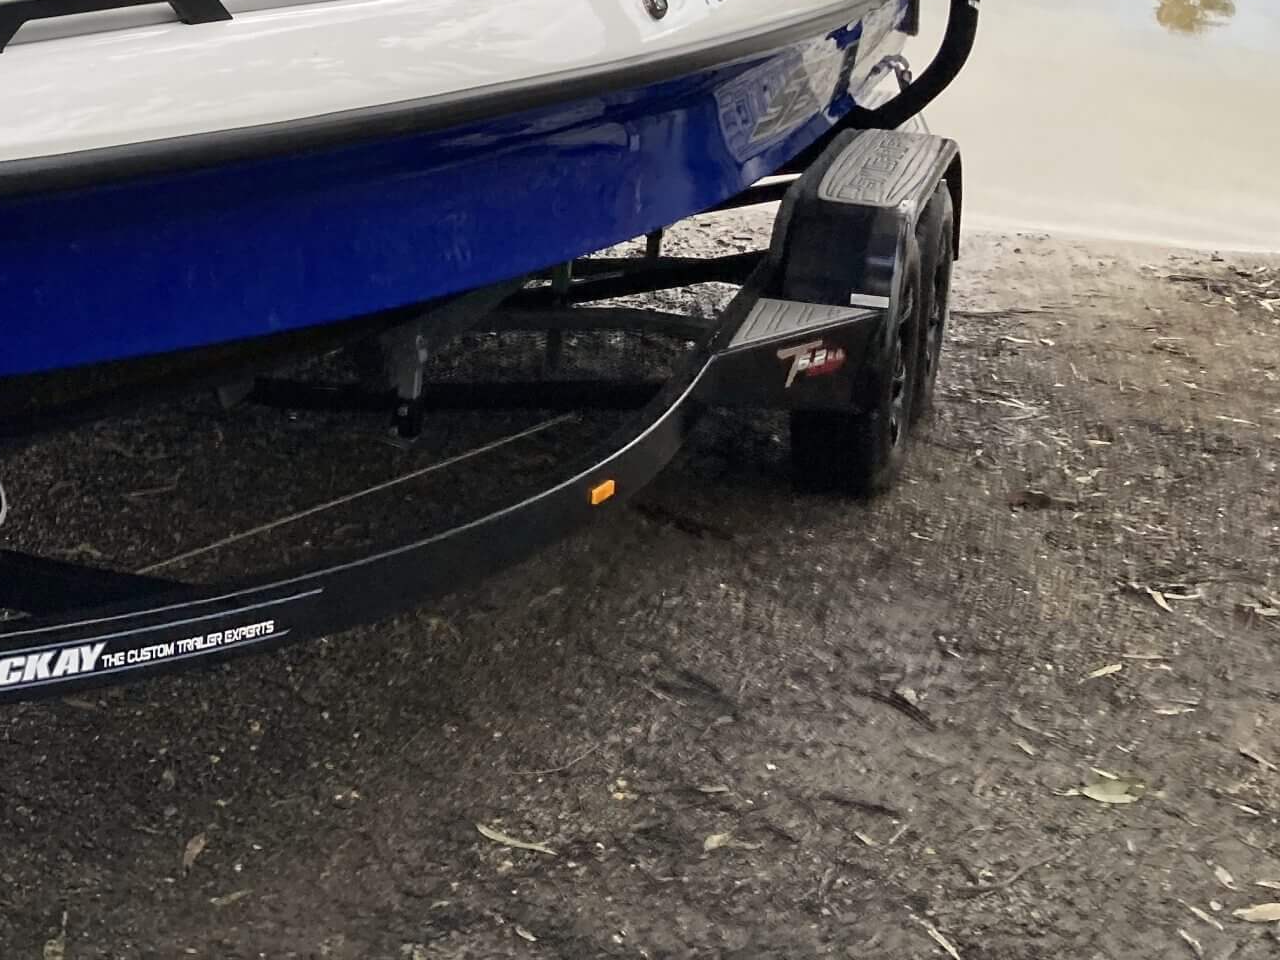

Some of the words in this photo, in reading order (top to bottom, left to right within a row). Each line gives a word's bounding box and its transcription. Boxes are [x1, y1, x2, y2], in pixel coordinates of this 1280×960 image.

[102, 651, 125, 668] THE
[127, 642, 175, 663] CUSTOM
[177, 632, 223, 654] TRAILER
[224, 620, 275, 643] EXPERTS
